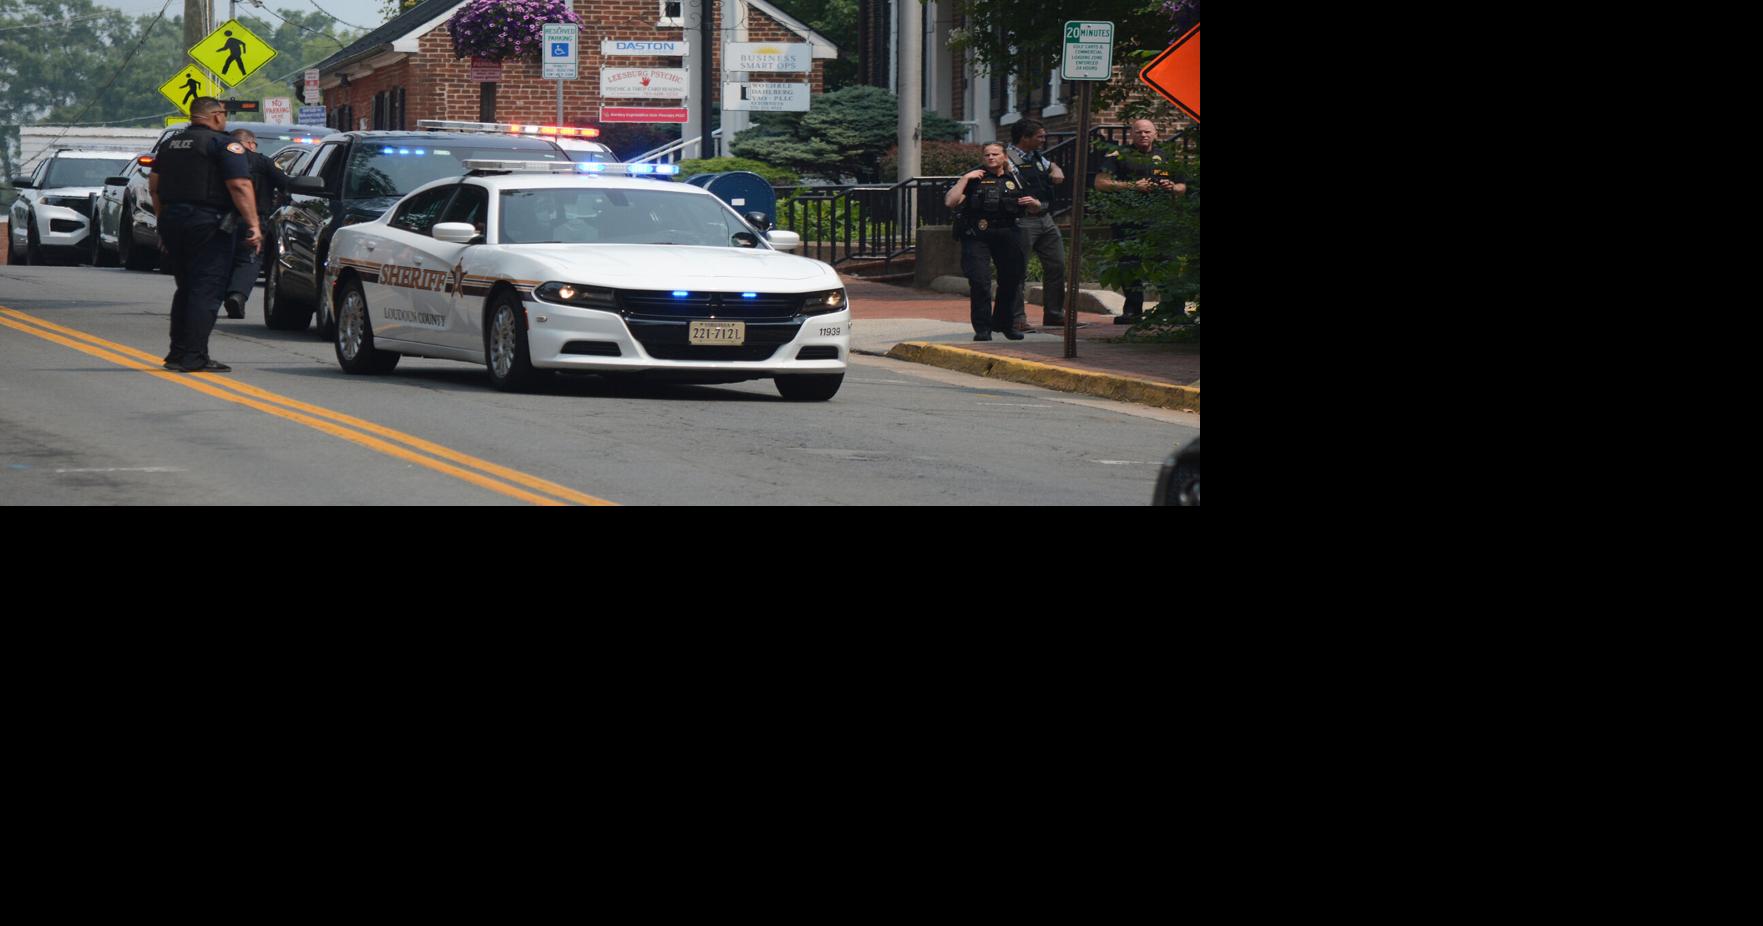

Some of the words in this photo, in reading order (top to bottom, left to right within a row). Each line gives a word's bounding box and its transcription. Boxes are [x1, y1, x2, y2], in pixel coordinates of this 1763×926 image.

[1066, 27, 1080, 38] 20
[1080, 29, 1110, 37] MINUTES
[616, 42, 674, 50] DASTON
[608, 70, 648, 83] LEESBURG
[651, 71, 684, 83] PSYCHIC
[169, 140, 194, 149] POLICE
[381, 264, 446, 292] SHERIFF
[417, 311, 446, 327] COUNTY
[693, 327, 741, 339] 221-712L
[819, 327, 841, 336] 11939
